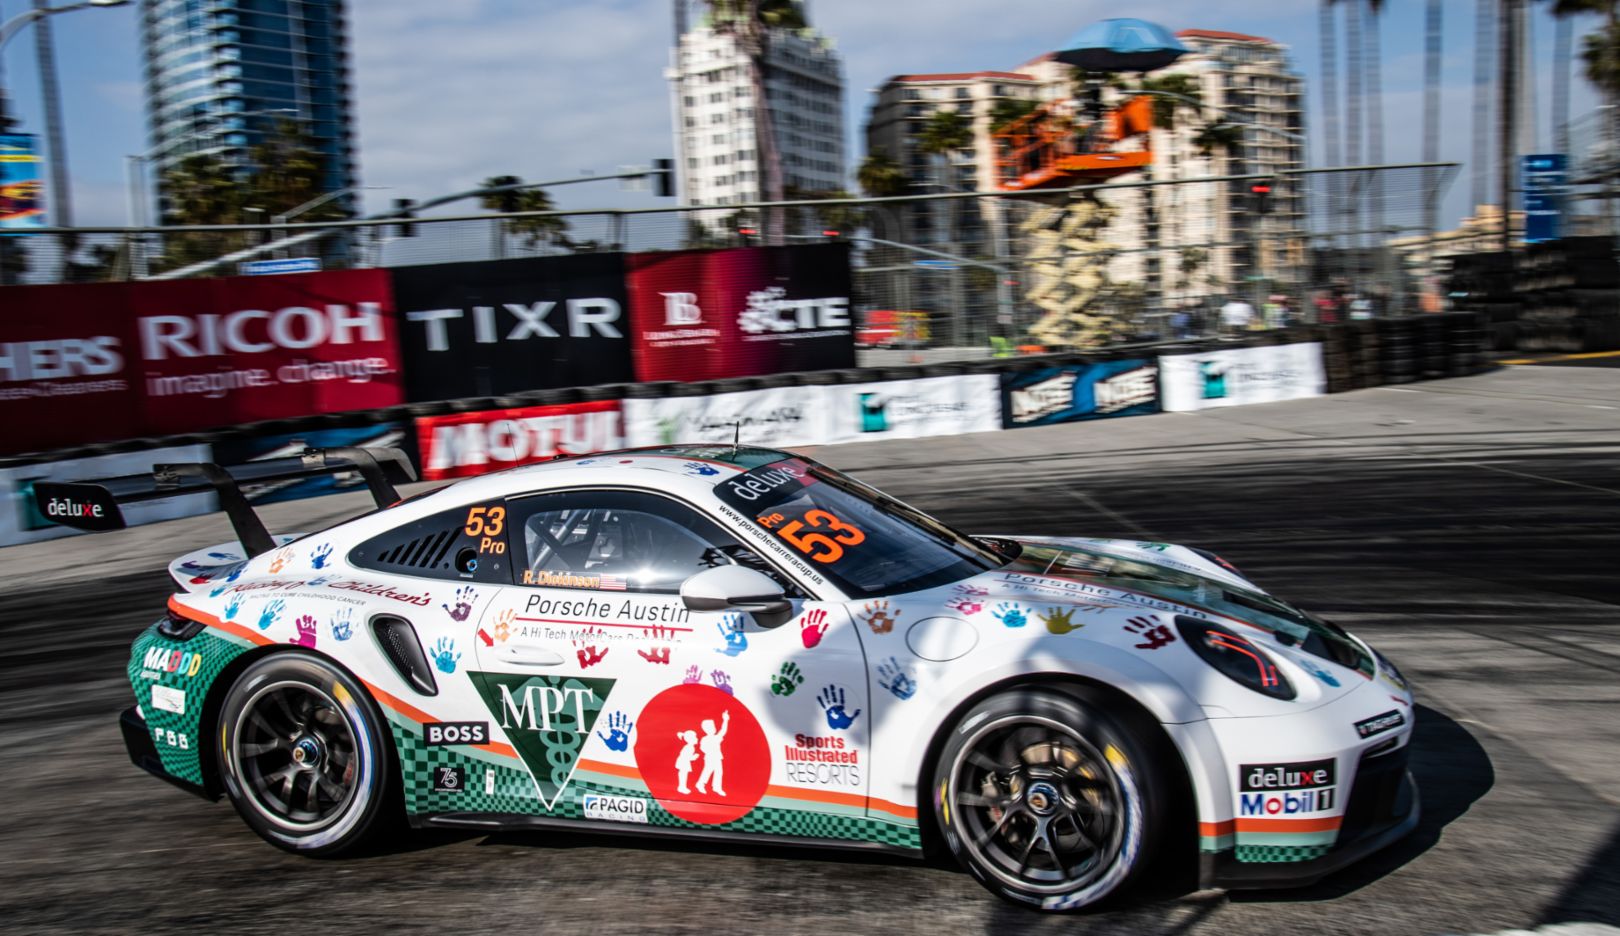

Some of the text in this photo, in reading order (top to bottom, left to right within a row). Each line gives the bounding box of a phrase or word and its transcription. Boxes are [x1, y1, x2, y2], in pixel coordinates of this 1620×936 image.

[139, 303, 387, 360] RICOH
[406, 297, 623, 351] TIXR
[427, 411, 626, 469] MOTUL
[728, 466, 805, 501] deluxe
[47, 498, 104, 517] deluxe
[465, 507, 506, 536] 53
[756, 512, 785, 529] Pro
[479, 537, 506, 554] Pro
[719, 504, 824, 585] www.porschecarreracup.us
[777, 509, 866, 563] 53
[523, 570, 538, 584] R.
[328, 581, 432, 606] Children's
[337, 595, 367, 606] CANCER
[1003, 573, 1208, 619] Porsche Austin
[525, 594, 690, 624] Porsche Austin
[520, 626, 528, 637] A
[530, 627, 541, 639] Hi
[545, 629, 567, 640] Tech
[143, 646, 202, 677] MADDD
[497, 683, 594, 734] MPT
[429, 725, 484, 743] BOSS
[795, 733, 845, 749] Sports
[784, 745, 858, 764] Illustrated
[440, 767, 458, 788] 75
[786, 762, 861, 786] RESORTS
[1248, 767, 1328, 788] deluxe
[600, 797, 644, 814] PAGID
[1240, 790, 1314, 816] Mobil
[586, 811, 646, 823] RACING
